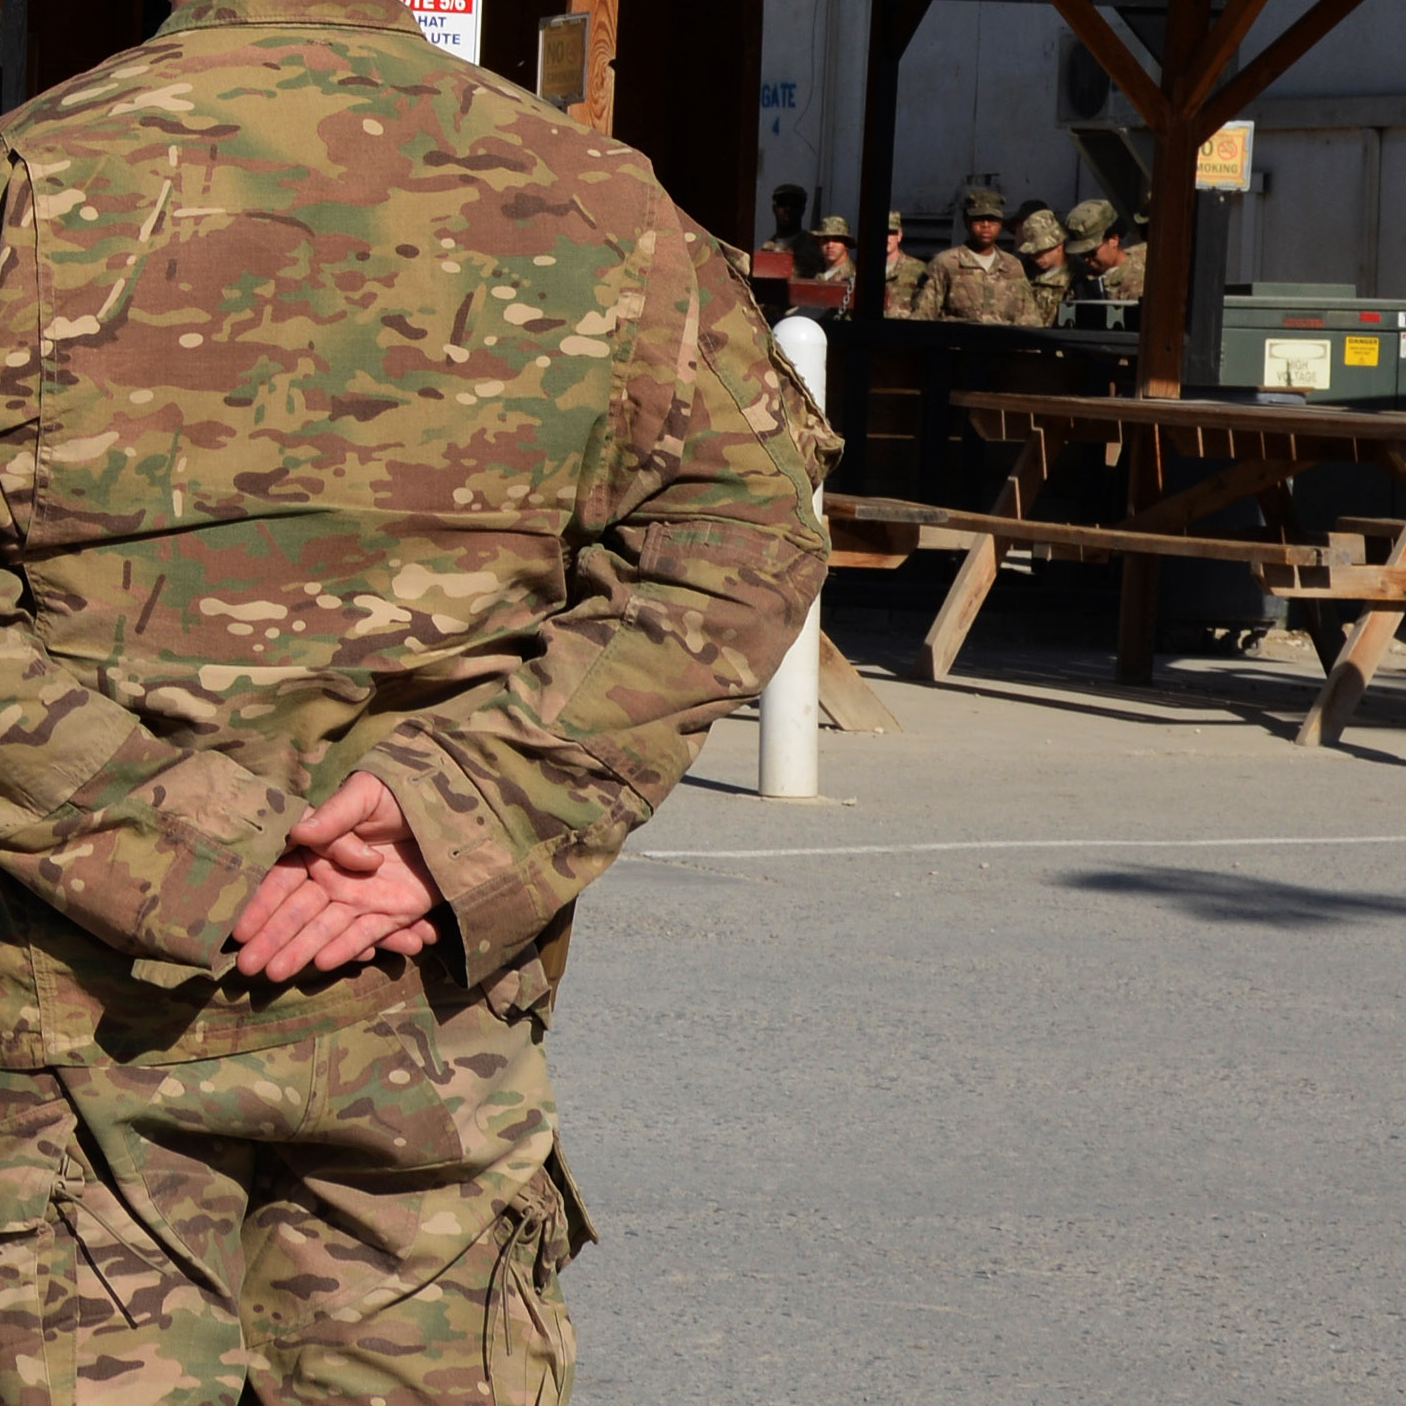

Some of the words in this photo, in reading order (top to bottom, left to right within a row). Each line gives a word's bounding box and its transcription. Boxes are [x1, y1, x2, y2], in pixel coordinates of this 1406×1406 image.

[418, 15, 447, 28] HAT
[430, 32, 461, 45] UTE
[762, 82, 796, 108] GATE
[772, 117, 781, 136] 4
[1201, 139, 1214, 157] O
[1197, 162, 1238, 175] MOKING
[1287, 360, 1308, 370] HIGH
[1276, 371, 1317, 383] VOLTAGE
